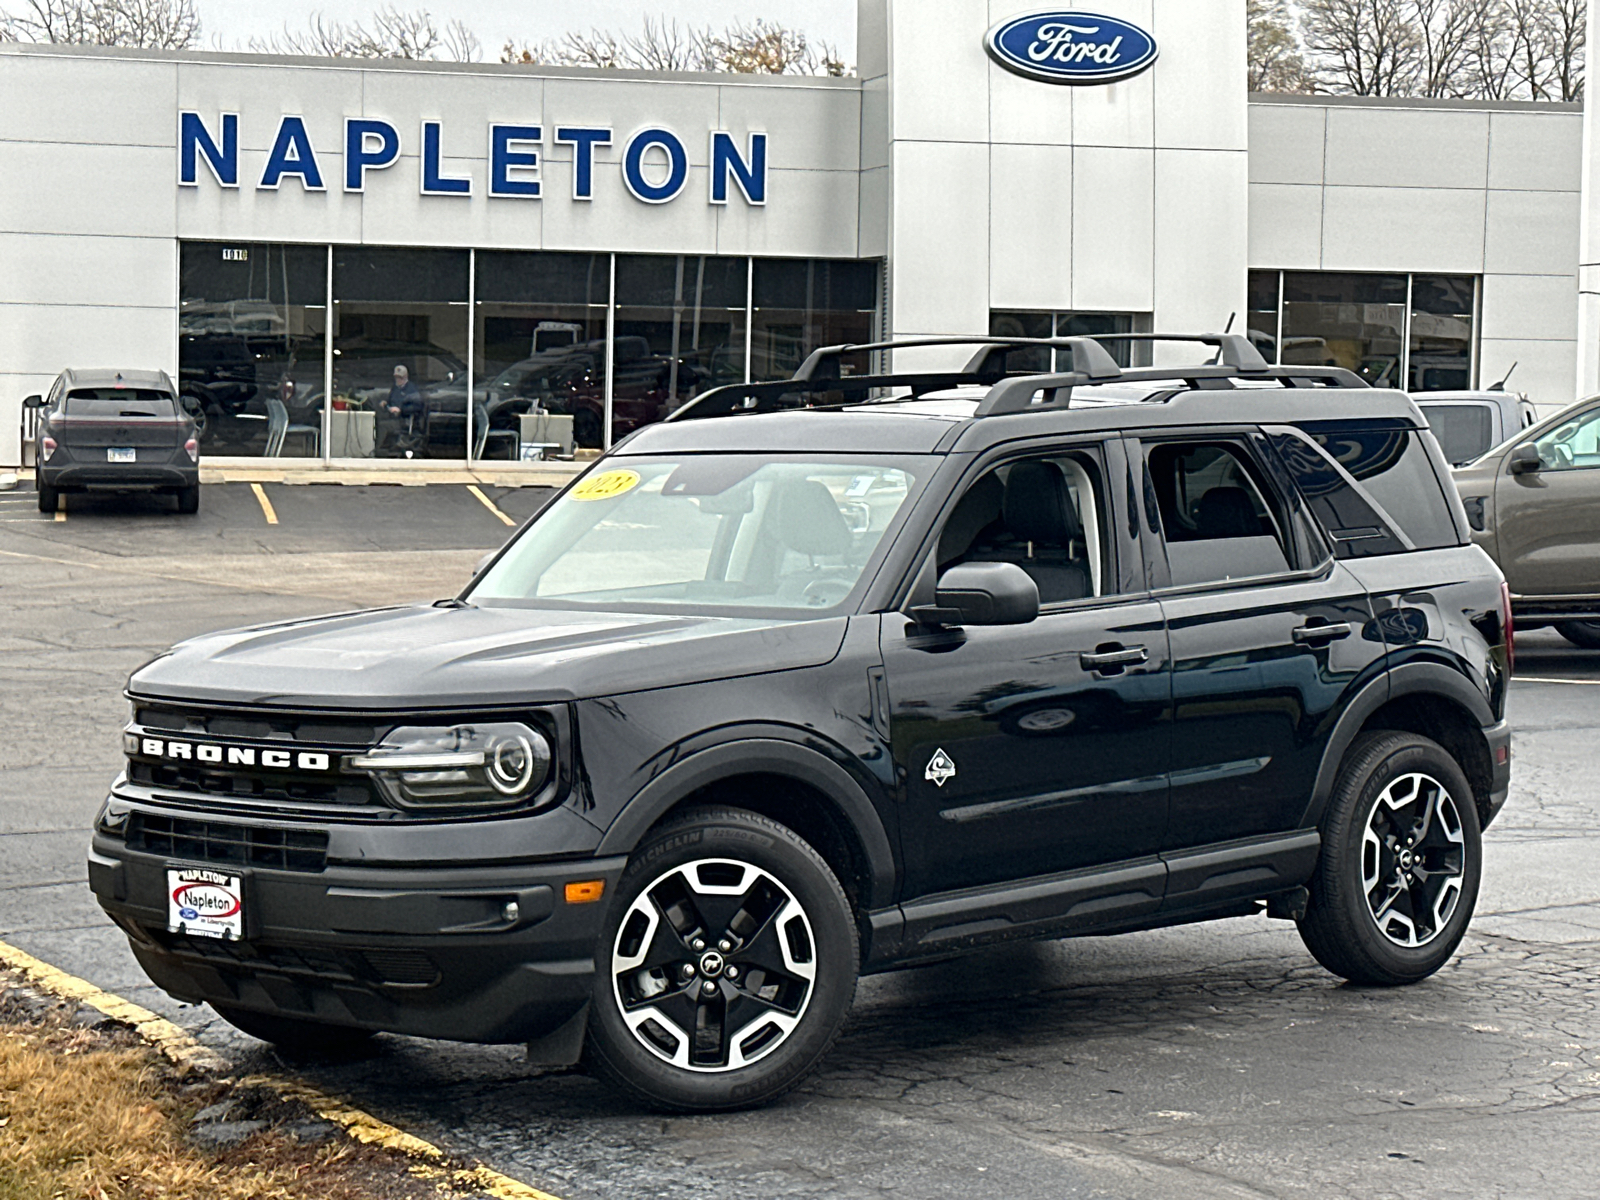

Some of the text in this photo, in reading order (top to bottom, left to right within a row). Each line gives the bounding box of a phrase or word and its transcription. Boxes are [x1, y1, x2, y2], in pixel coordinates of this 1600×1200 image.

[1028, 22, 1123, 64] Ford
[177, 109, 768, 206] NAPLETON
[142, 738, 329, 770] BRONCO
[629, 831, 701, 875] MICHELIN
[178, 870, 229, 885] NAPLETON
[184, 889, 230, 911] Napleton
